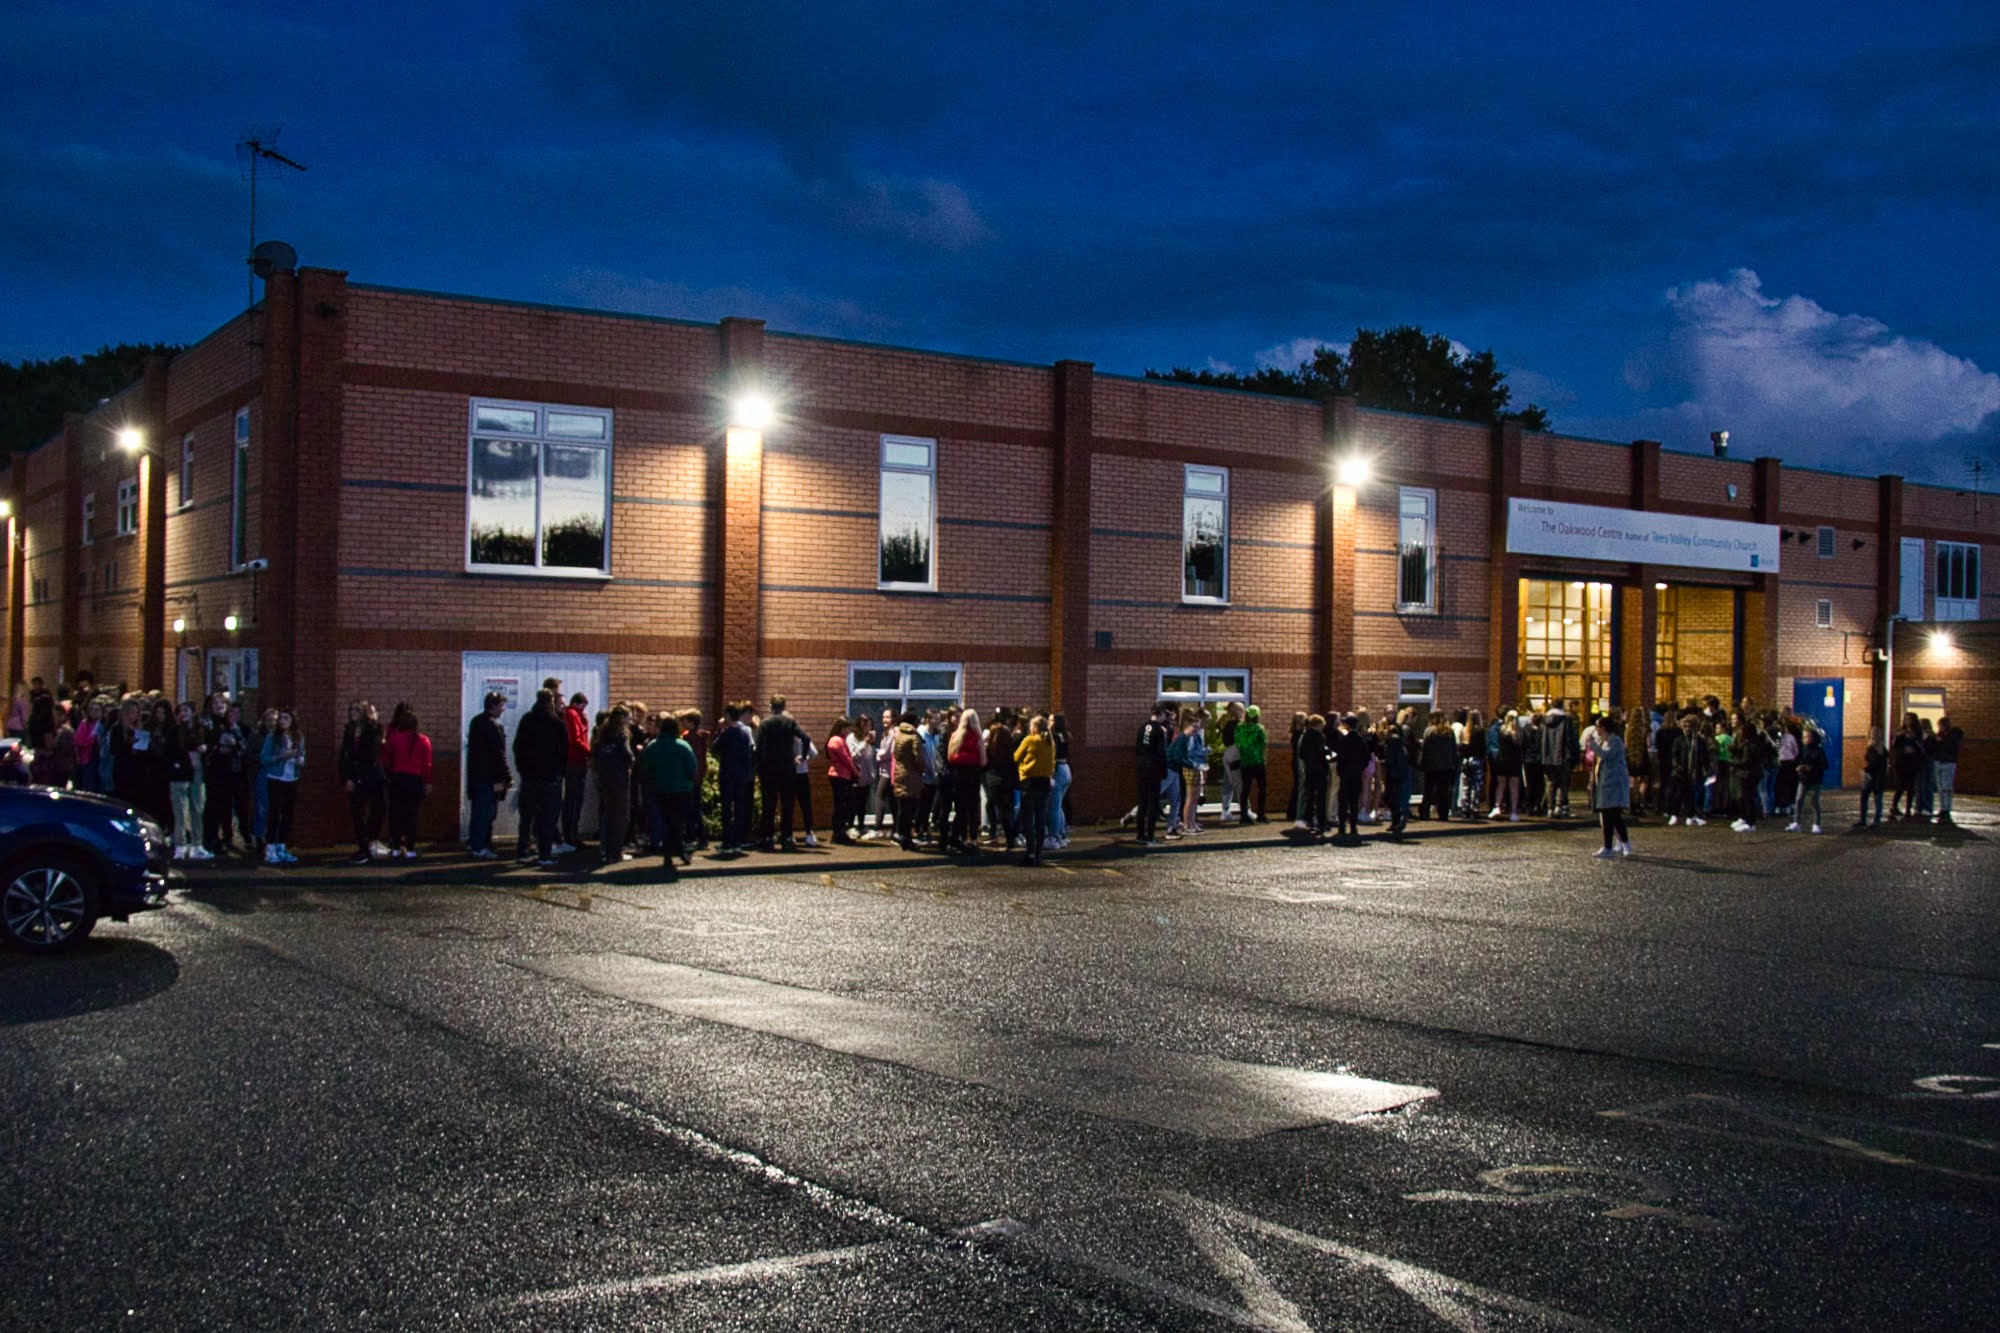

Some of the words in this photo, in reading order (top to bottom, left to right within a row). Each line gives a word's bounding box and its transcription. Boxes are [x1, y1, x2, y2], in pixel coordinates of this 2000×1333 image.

[1518, 503, 1545, 514] Welcome
[1547, 506, 1554, 515] to
[1542, 521, 1556, 534] The
[1558, 522, 1595, 537] Oakwood
[1598, 526, 1623, 540] Centre
[1670, 533, 1690, 546] Valley
[1693, 535, 1732, 551] Community
[1734, 538, 1758, 551] Church
